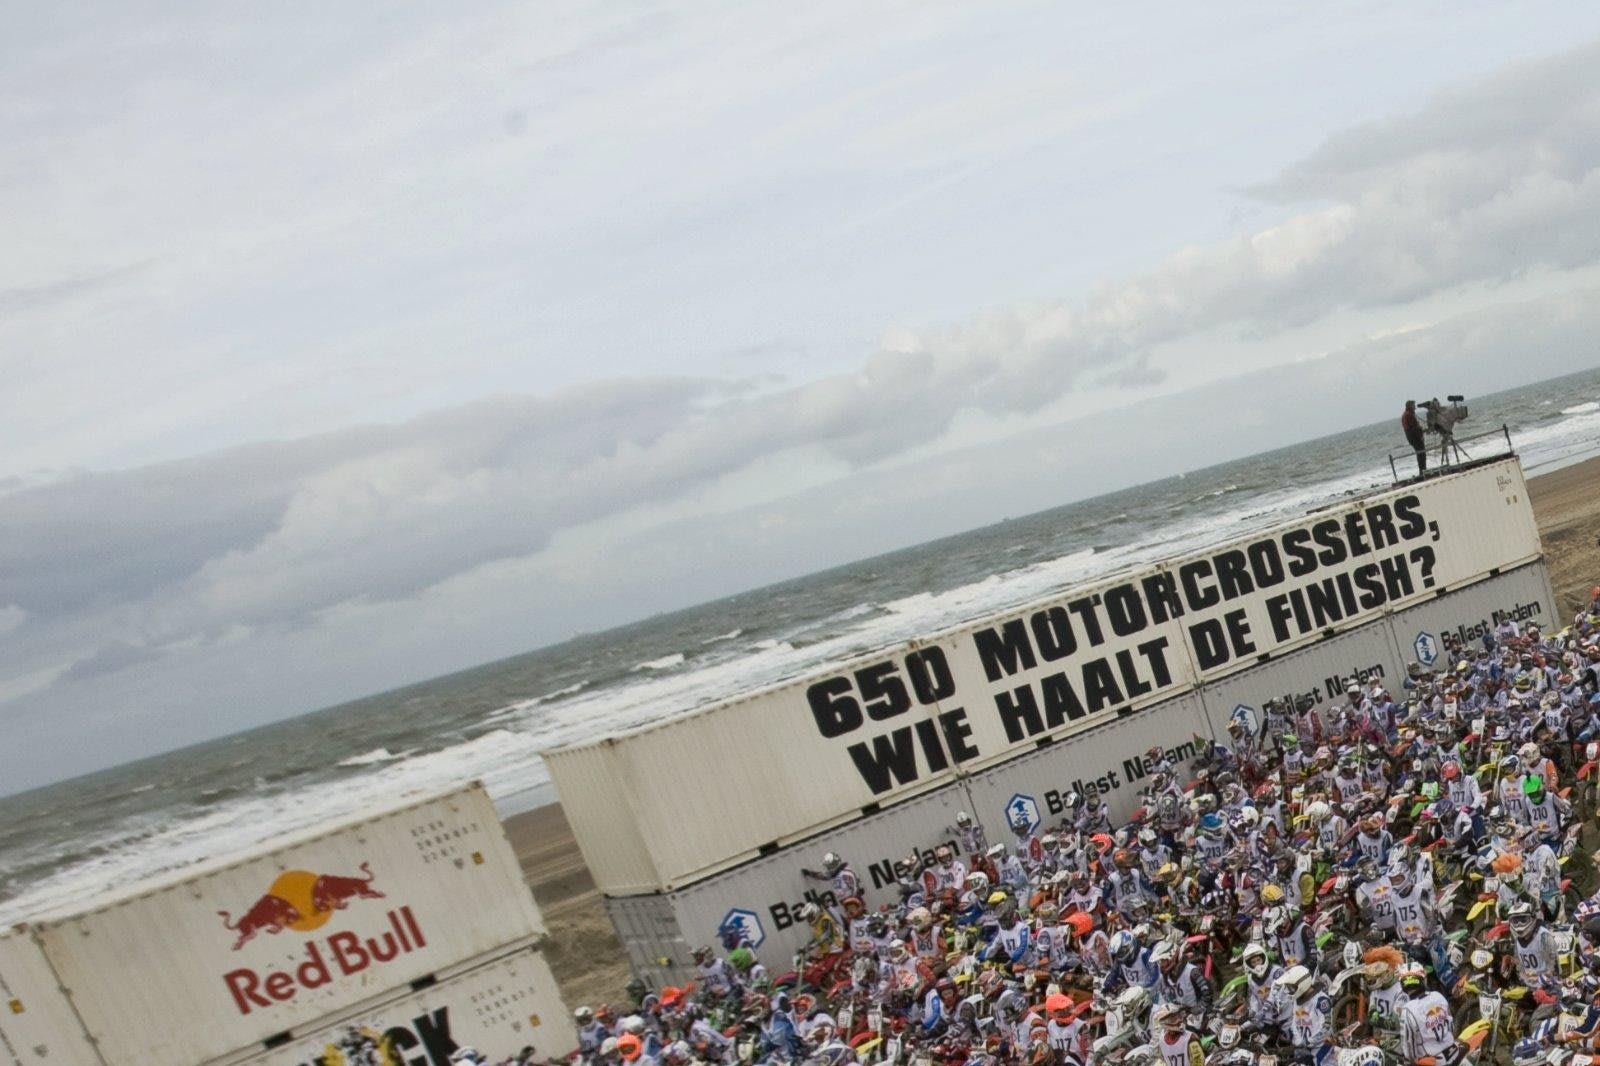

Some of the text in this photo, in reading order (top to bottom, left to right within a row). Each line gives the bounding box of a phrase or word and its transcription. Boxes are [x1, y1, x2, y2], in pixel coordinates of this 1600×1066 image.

[807, 495, 1440, 738] 650 MOTORCROSSERS,
[847, 546, 1437, 795] WIE HAALT DE FINISH?
[223, 905, 427, 1015] Red Bull
[1399, 907, 1418, 921] 175
